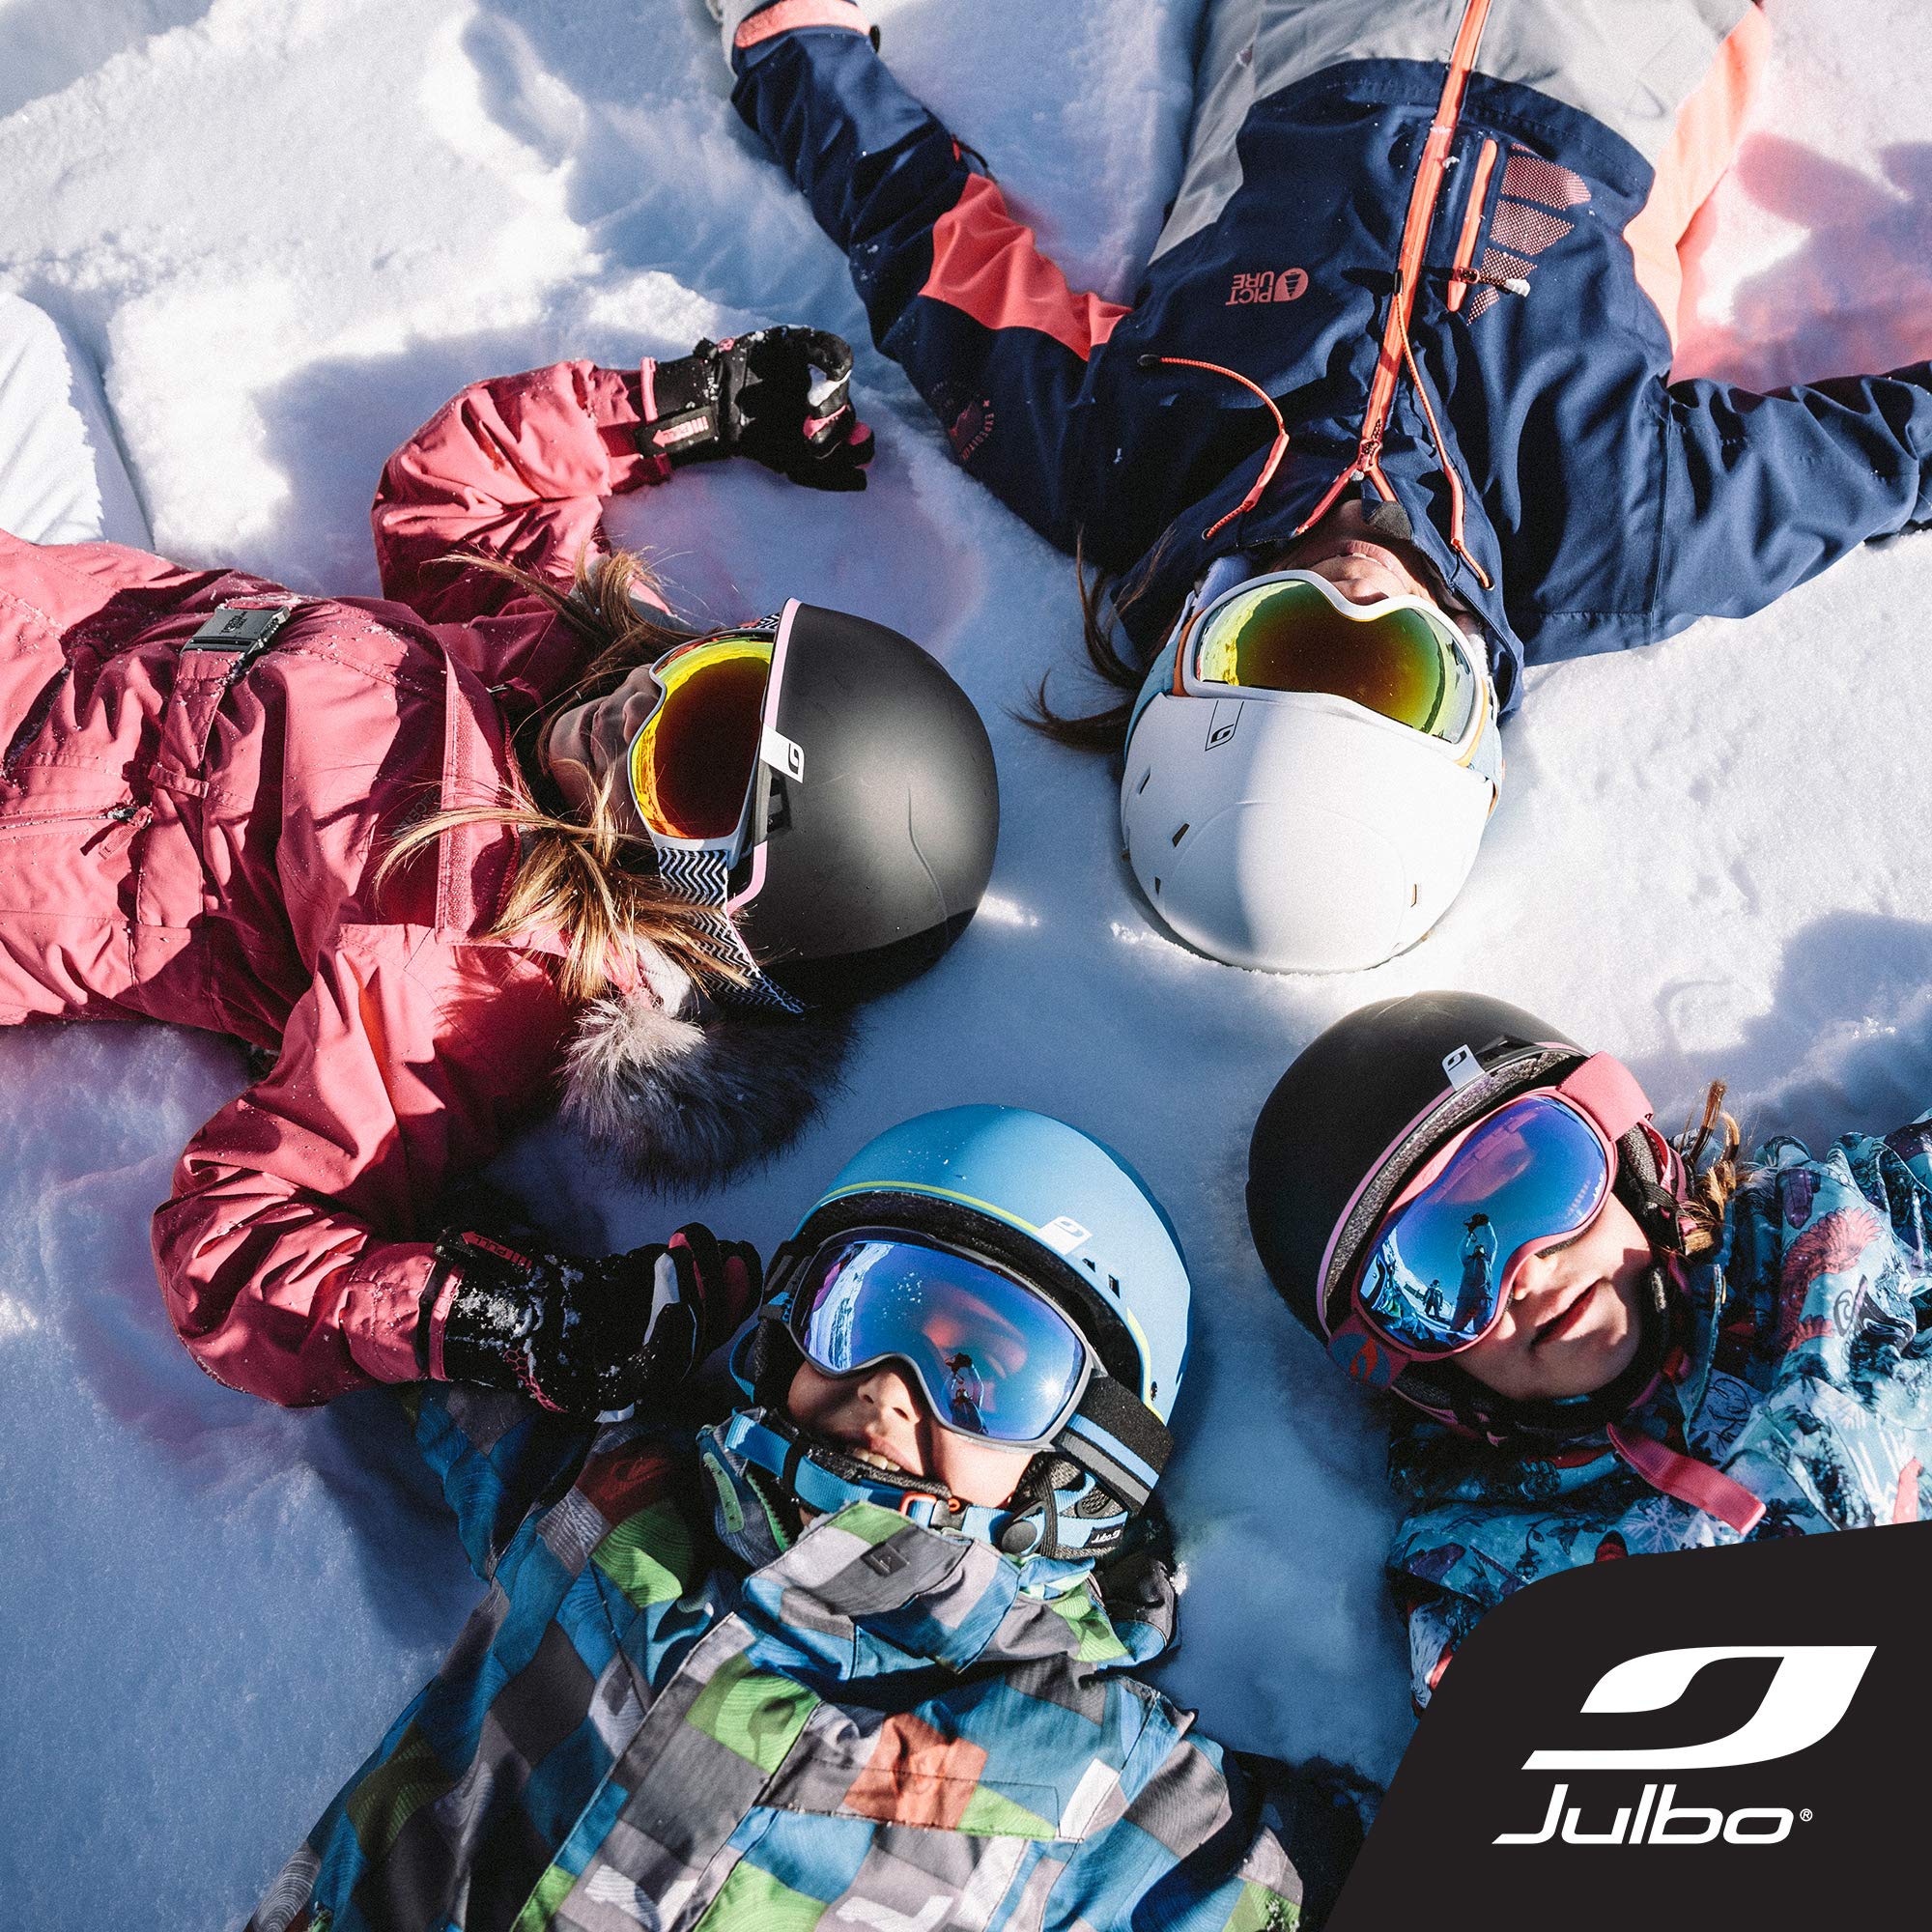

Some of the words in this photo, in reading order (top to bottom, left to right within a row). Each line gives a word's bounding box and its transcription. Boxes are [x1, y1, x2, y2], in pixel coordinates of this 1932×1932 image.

[1232, 271, 1275, 290] URE
[1225, 286, 1273, 306] PICT
[475, 1236, 507, 1256] PULL
